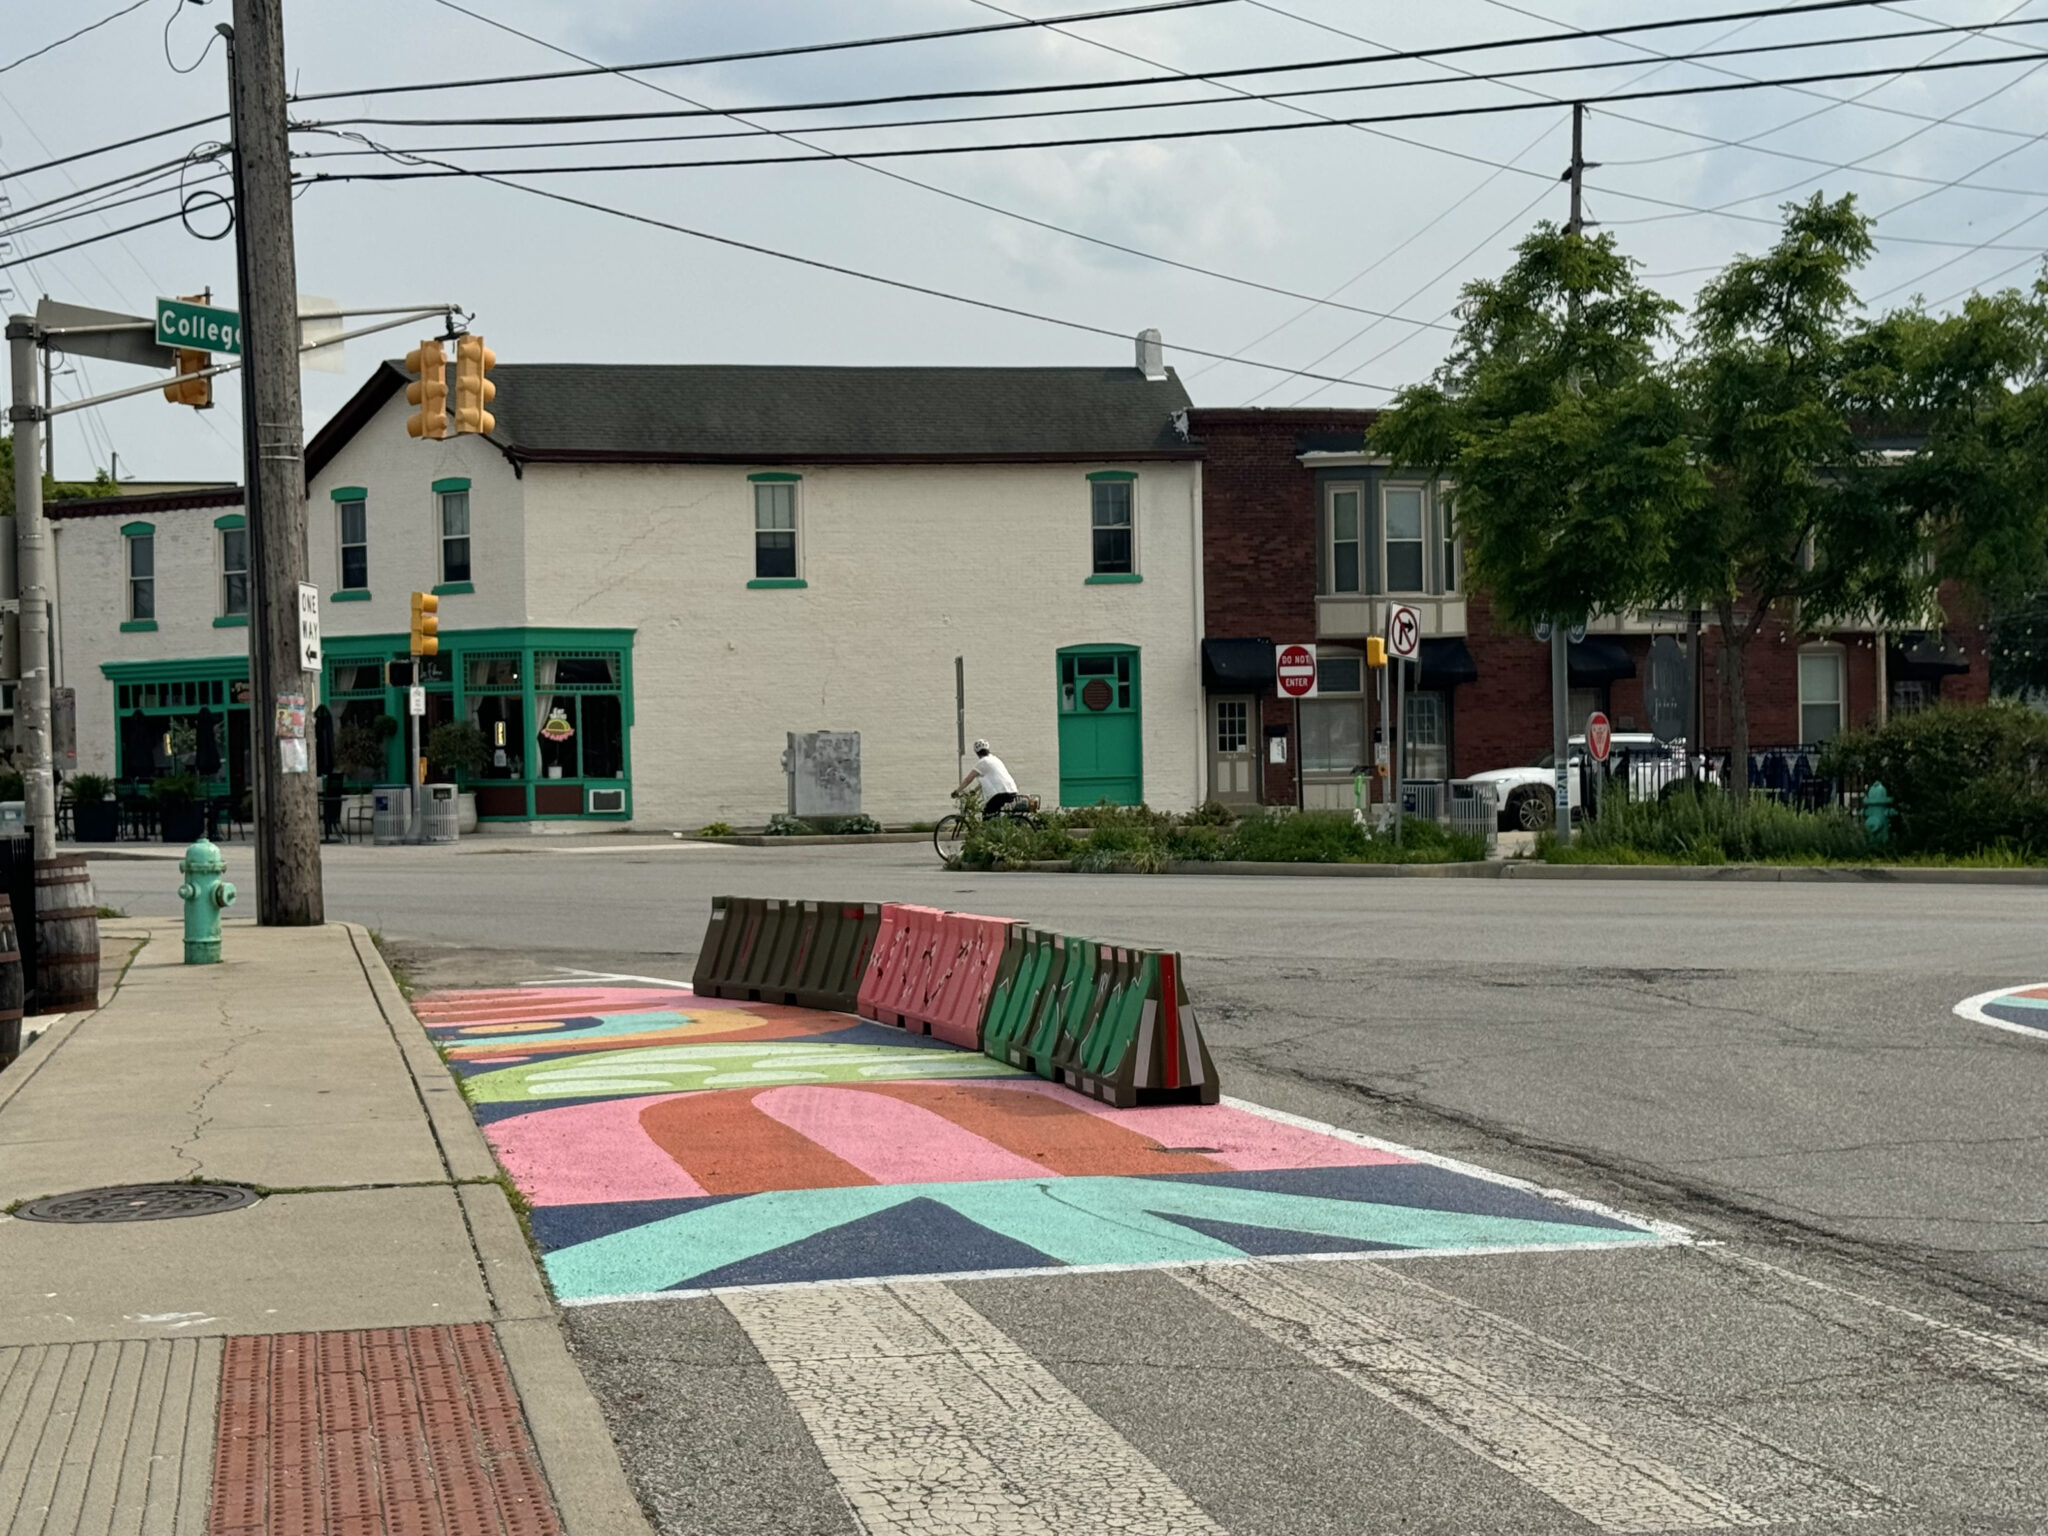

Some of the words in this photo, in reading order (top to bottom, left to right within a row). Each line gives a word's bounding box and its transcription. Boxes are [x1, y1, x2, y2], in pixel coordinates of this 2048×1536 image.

[302, 592, 317, 614] ONE
[302, 620, 318, 641] WAY
[1282, 655, 1292, 665] DO
[1294, 655, 1310, 665] NOT
[1285, 677, 1308, 687] ENTER
